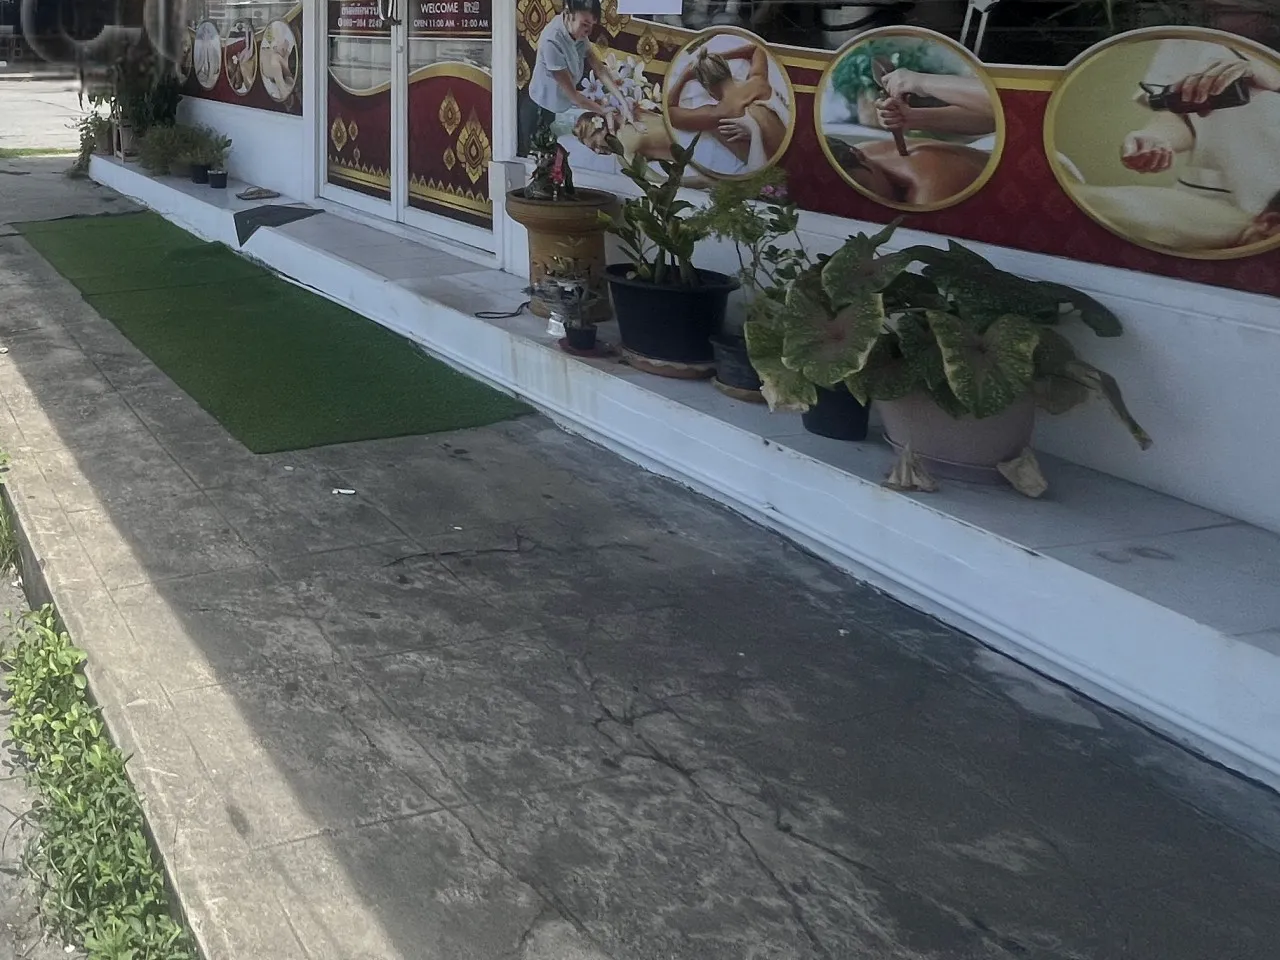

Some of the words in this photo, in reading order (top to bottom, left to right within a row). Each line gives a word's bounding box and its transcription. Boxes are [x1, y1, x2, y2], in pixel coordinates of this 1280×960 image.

[420, 2, 459, 14] WELCOME
[414, 19, 428, 28] OPEN
[445, 19, 456, 28] AM
[478, 19, 489, 28] AM
